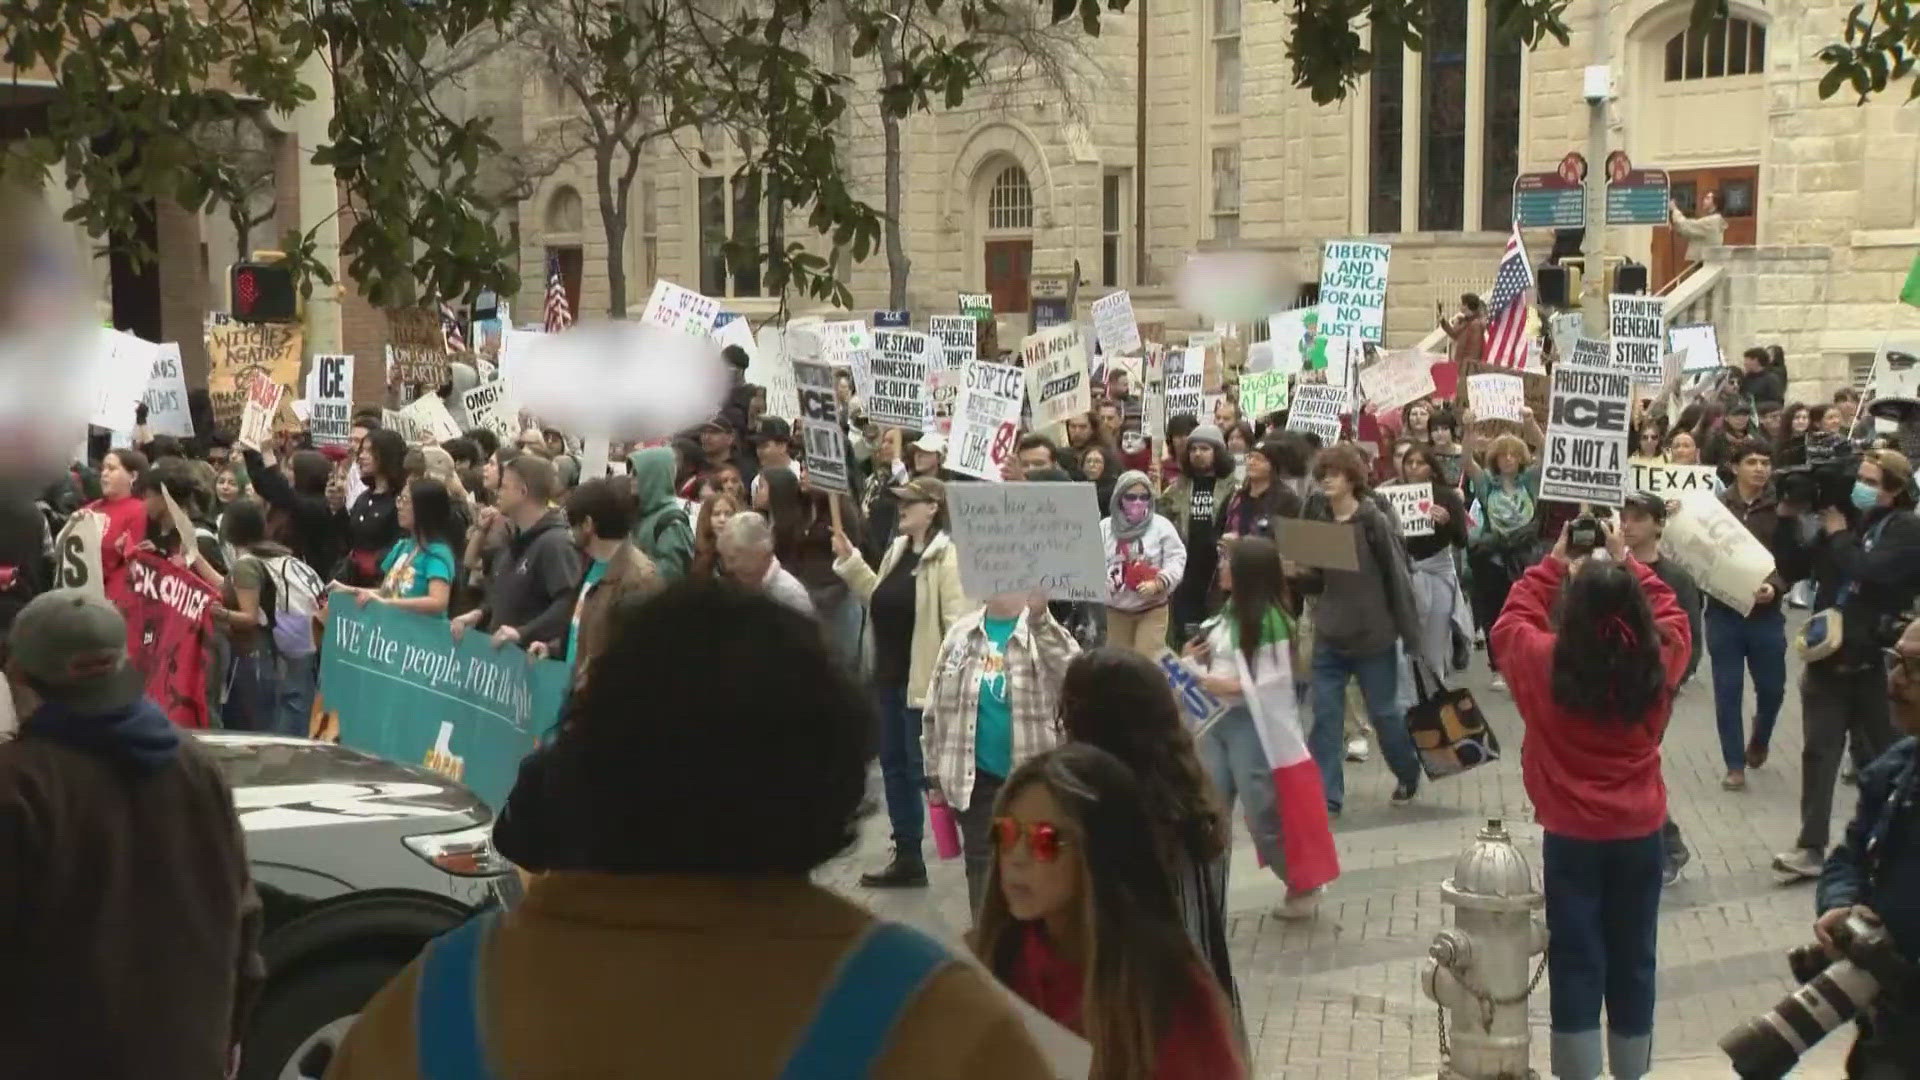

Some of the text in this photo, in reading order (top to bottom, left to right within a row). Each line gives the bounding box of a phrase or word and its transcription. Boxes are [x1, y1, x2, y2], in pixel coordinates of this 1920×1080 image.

[1326, 244, 1389, 262] LIBERTY
[1337, 261, 1374, 275] AND
[1323, 272, 1387, 291] JUSTICE
[679, 293, 712, 318] WILL
[959, 294, 992, 310] PROTECT
[1320, 289, 1384, 309] FOR ALL?
[1612, 299, 1663, 316] EXPAND THE
[932, 318, 975, 332] EXPAND THE
[1359, 326, 1382, 340] ICE
[1612, 317, 1662, 339] GENERAL
[212, 328, 292, 350] WITCHES
[874, 331, 925, 354] WE STAND
[943, 350, 973, 366] TRIKE!
[1616, 342, 1659, 364] STRIKE!
[319, 357, 345, 398] ICE
[870, 359, 925, 382] MINNESOTA!
[966, 362, 1022, 400] STOP ICE
[874, 379, 921, 399] ICE OUT OF
[1554, 369, 1629, 397] PROTESTING
[466, 385, 499, 410] OMG!
[869, 397, 924, 418] EVERYWHERE!
[314, 404, 347, 421] OUT OF OUR
[1551, 397, 1628, 432] ICE
[1550, 436, 1620, 470] IS NOT A
[1545, 467, 1622, 487] CRIME!
[1630, 465, 1714, 492] TEXAS
[1401, 502, 1416, 514] IS
[335, 614, 363, 655] WE
[367, 625, 399, 664] the
[463, 656, 499, 699] FOR
